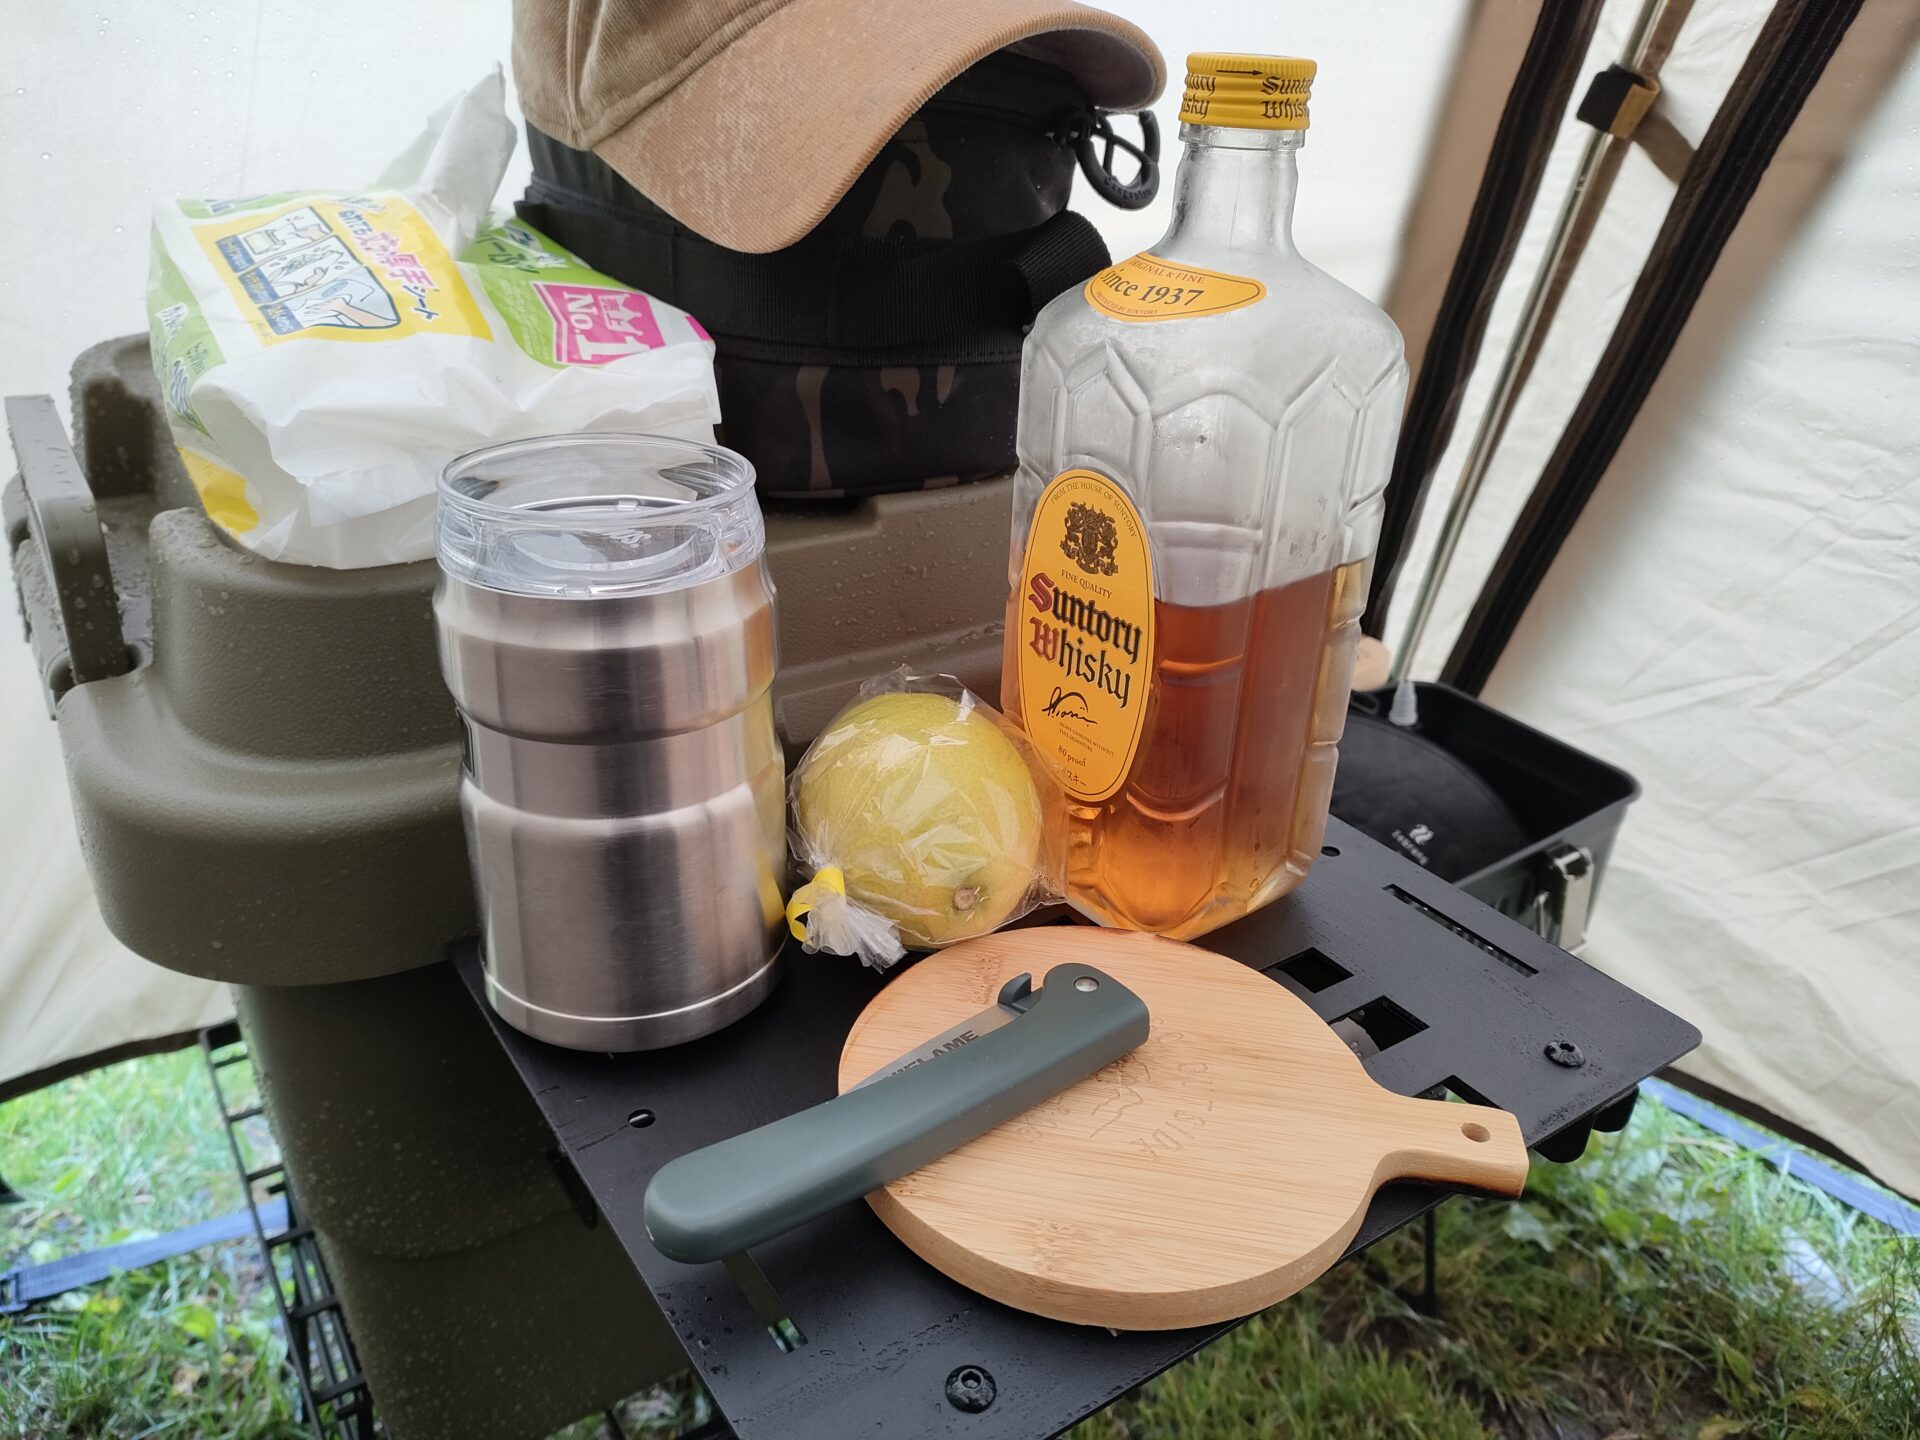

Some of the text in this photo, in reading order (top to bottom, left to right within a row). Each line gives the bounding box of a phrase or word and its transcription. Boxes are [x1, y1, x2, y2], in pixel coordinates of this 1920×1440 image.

[1100, 268, 1204, 307] since 1937
[1174, 272, 1205, 284] FINE
[1051, 481, 1138, 537] FROM THE HOUSE OF SUNTORY
[1061, 569, 1113, 599] FINE QUALITY
[1028, 572, 1143, 665] Suntory
[1029, 616, 1131, 709] Whisky
[1058, 745, 1087, 767] 80 proof
[1092, 740, 1115, 757] WITHOUT
